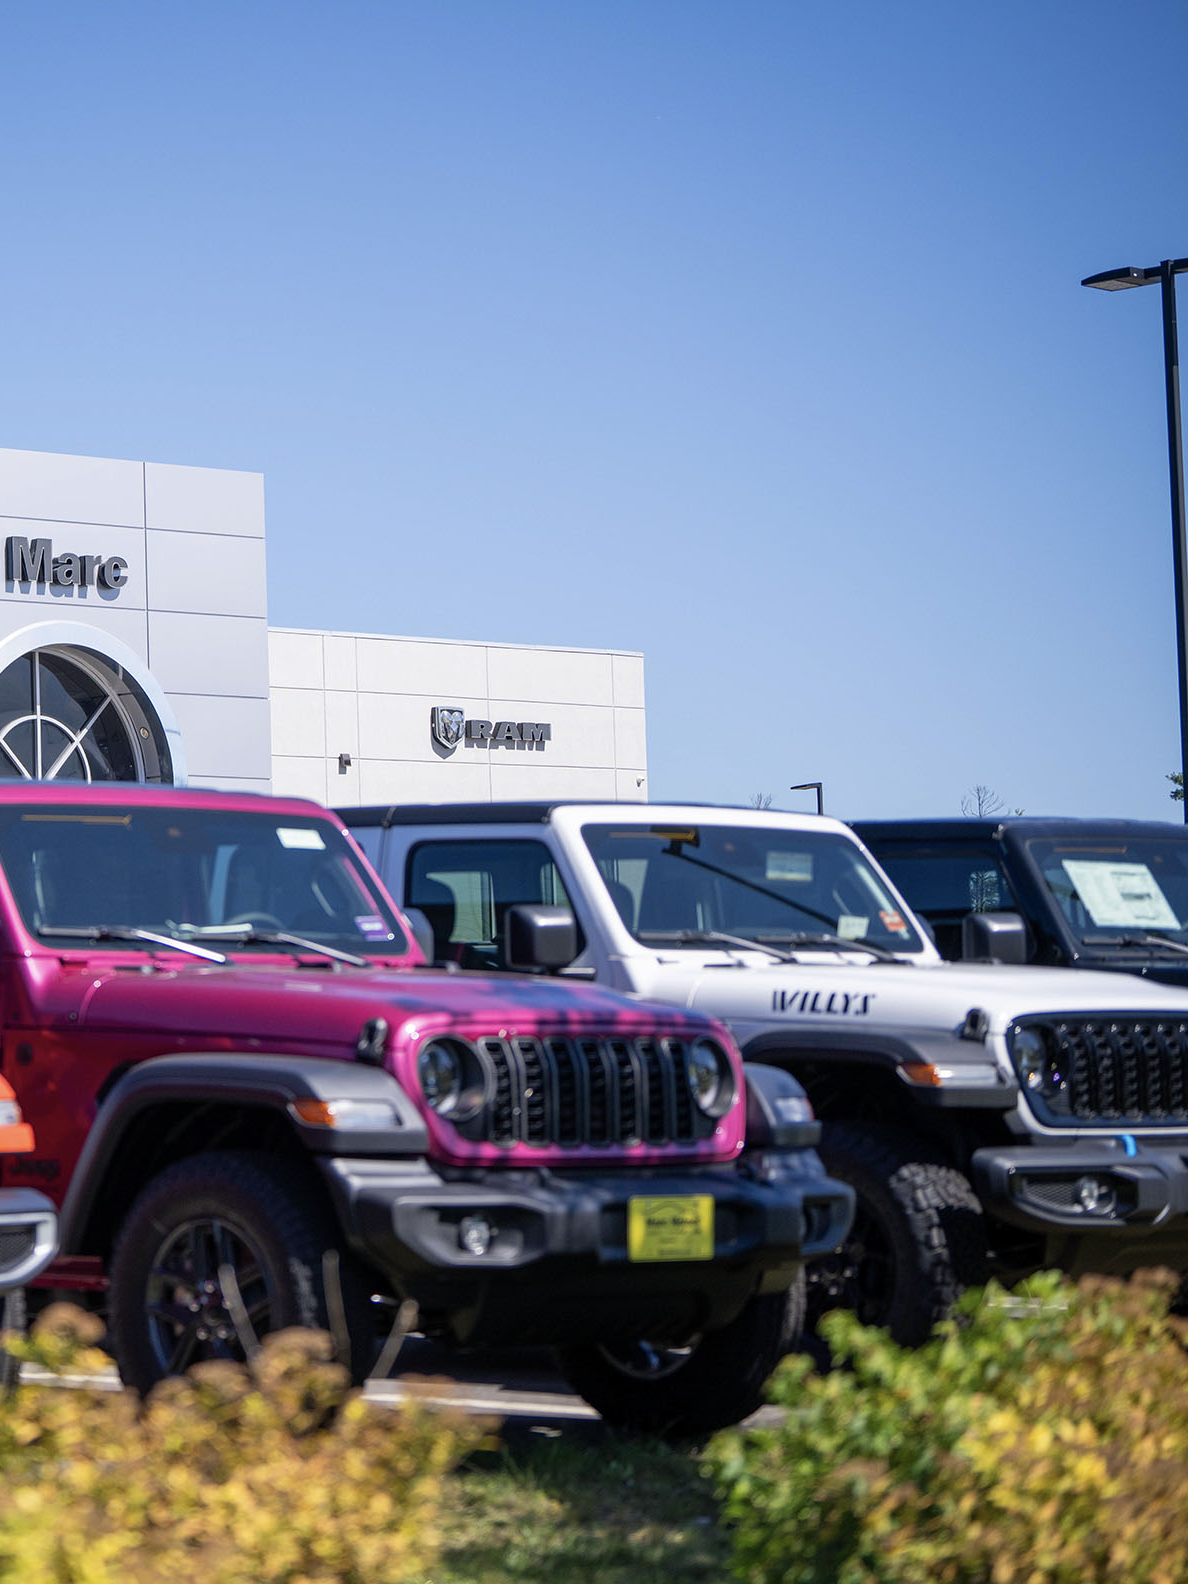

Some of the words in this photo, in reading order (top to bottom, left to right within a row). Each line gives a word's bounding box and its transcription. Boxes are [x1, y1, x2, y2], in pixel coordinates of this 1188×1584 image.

[5, 536, 129, 589] Marc
[465, 720, 552, 741] RAM
[772, 990, 877, 1015] WILLYS
